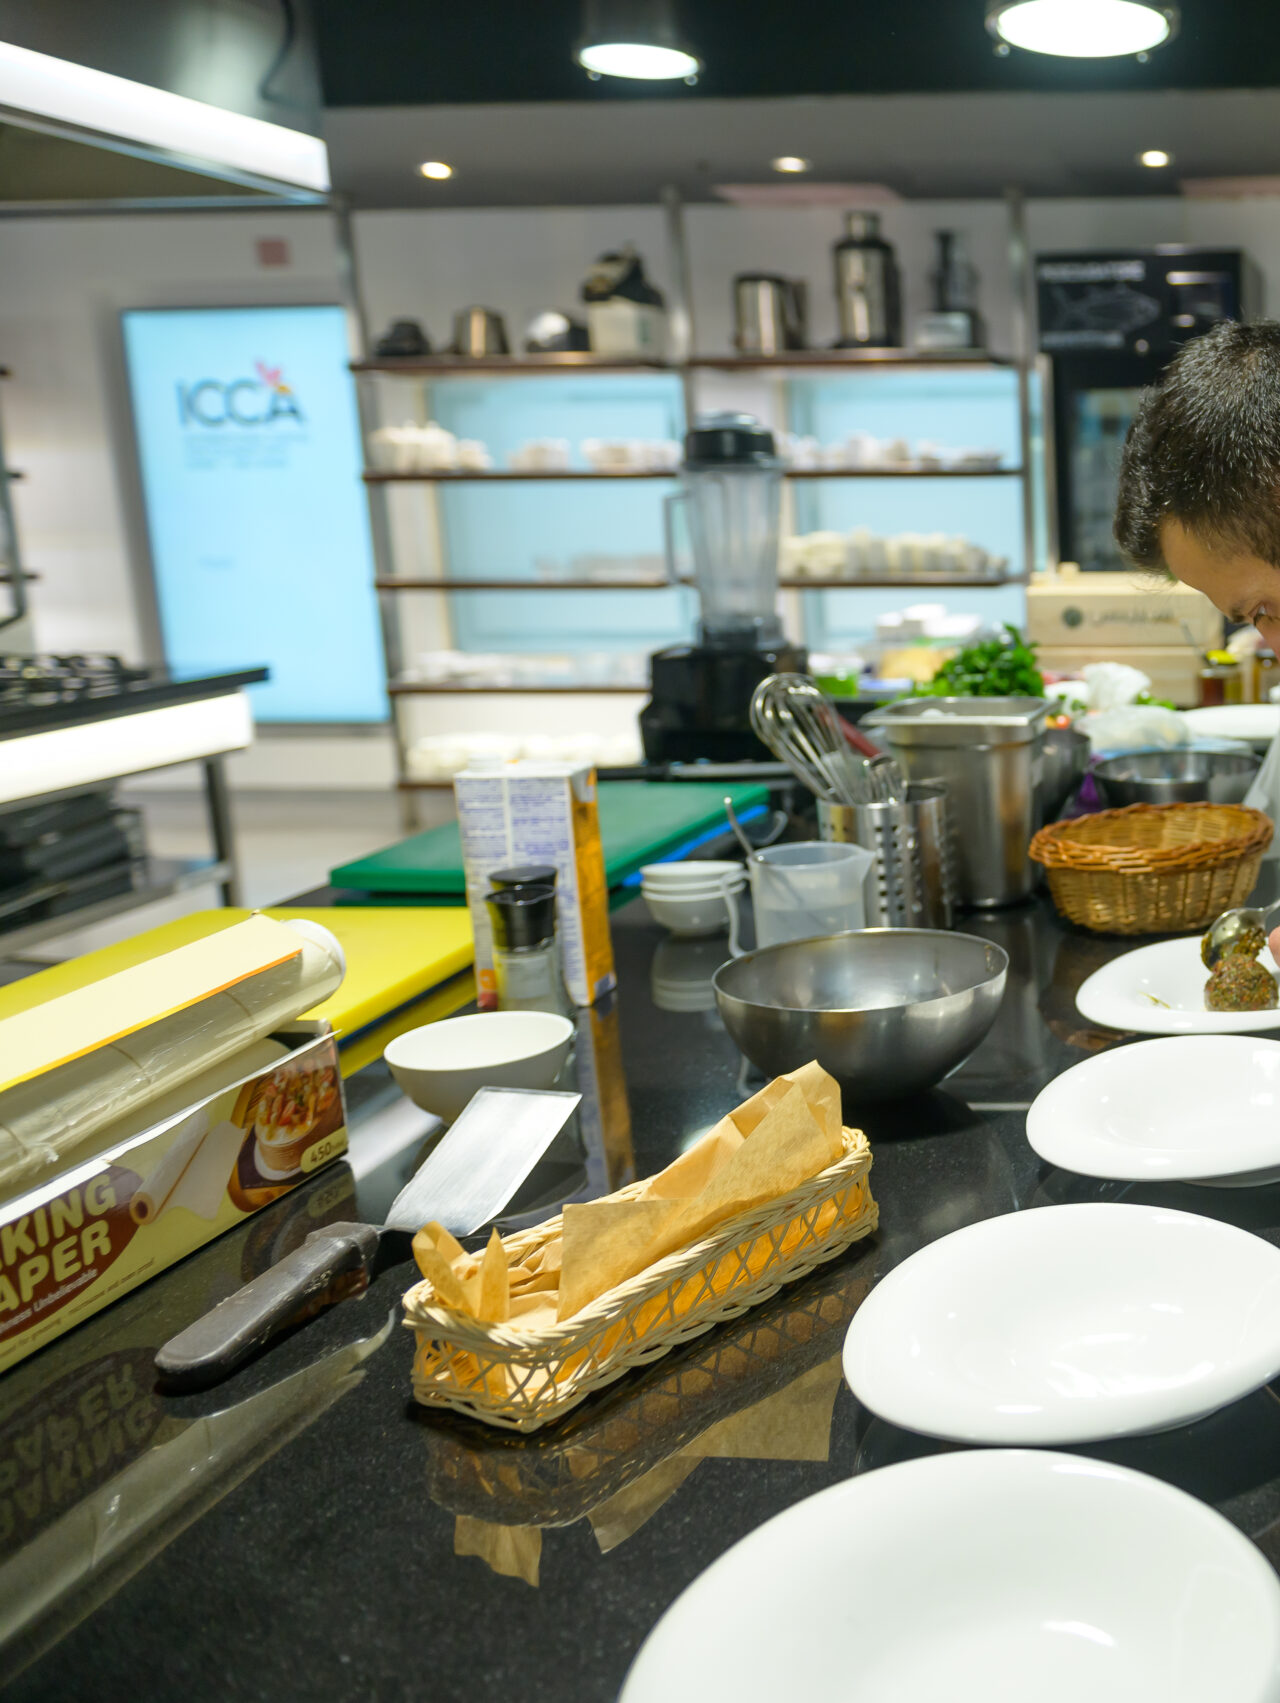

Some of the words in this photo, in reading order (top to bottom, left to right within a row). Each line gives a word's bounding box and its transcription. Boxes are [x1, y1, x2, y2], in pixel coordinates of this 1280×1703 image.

[174, 378, 307, 428] ICCA
[310, 1141, 331, 1163] 450
[0, 1173, 116, 1267] KING
